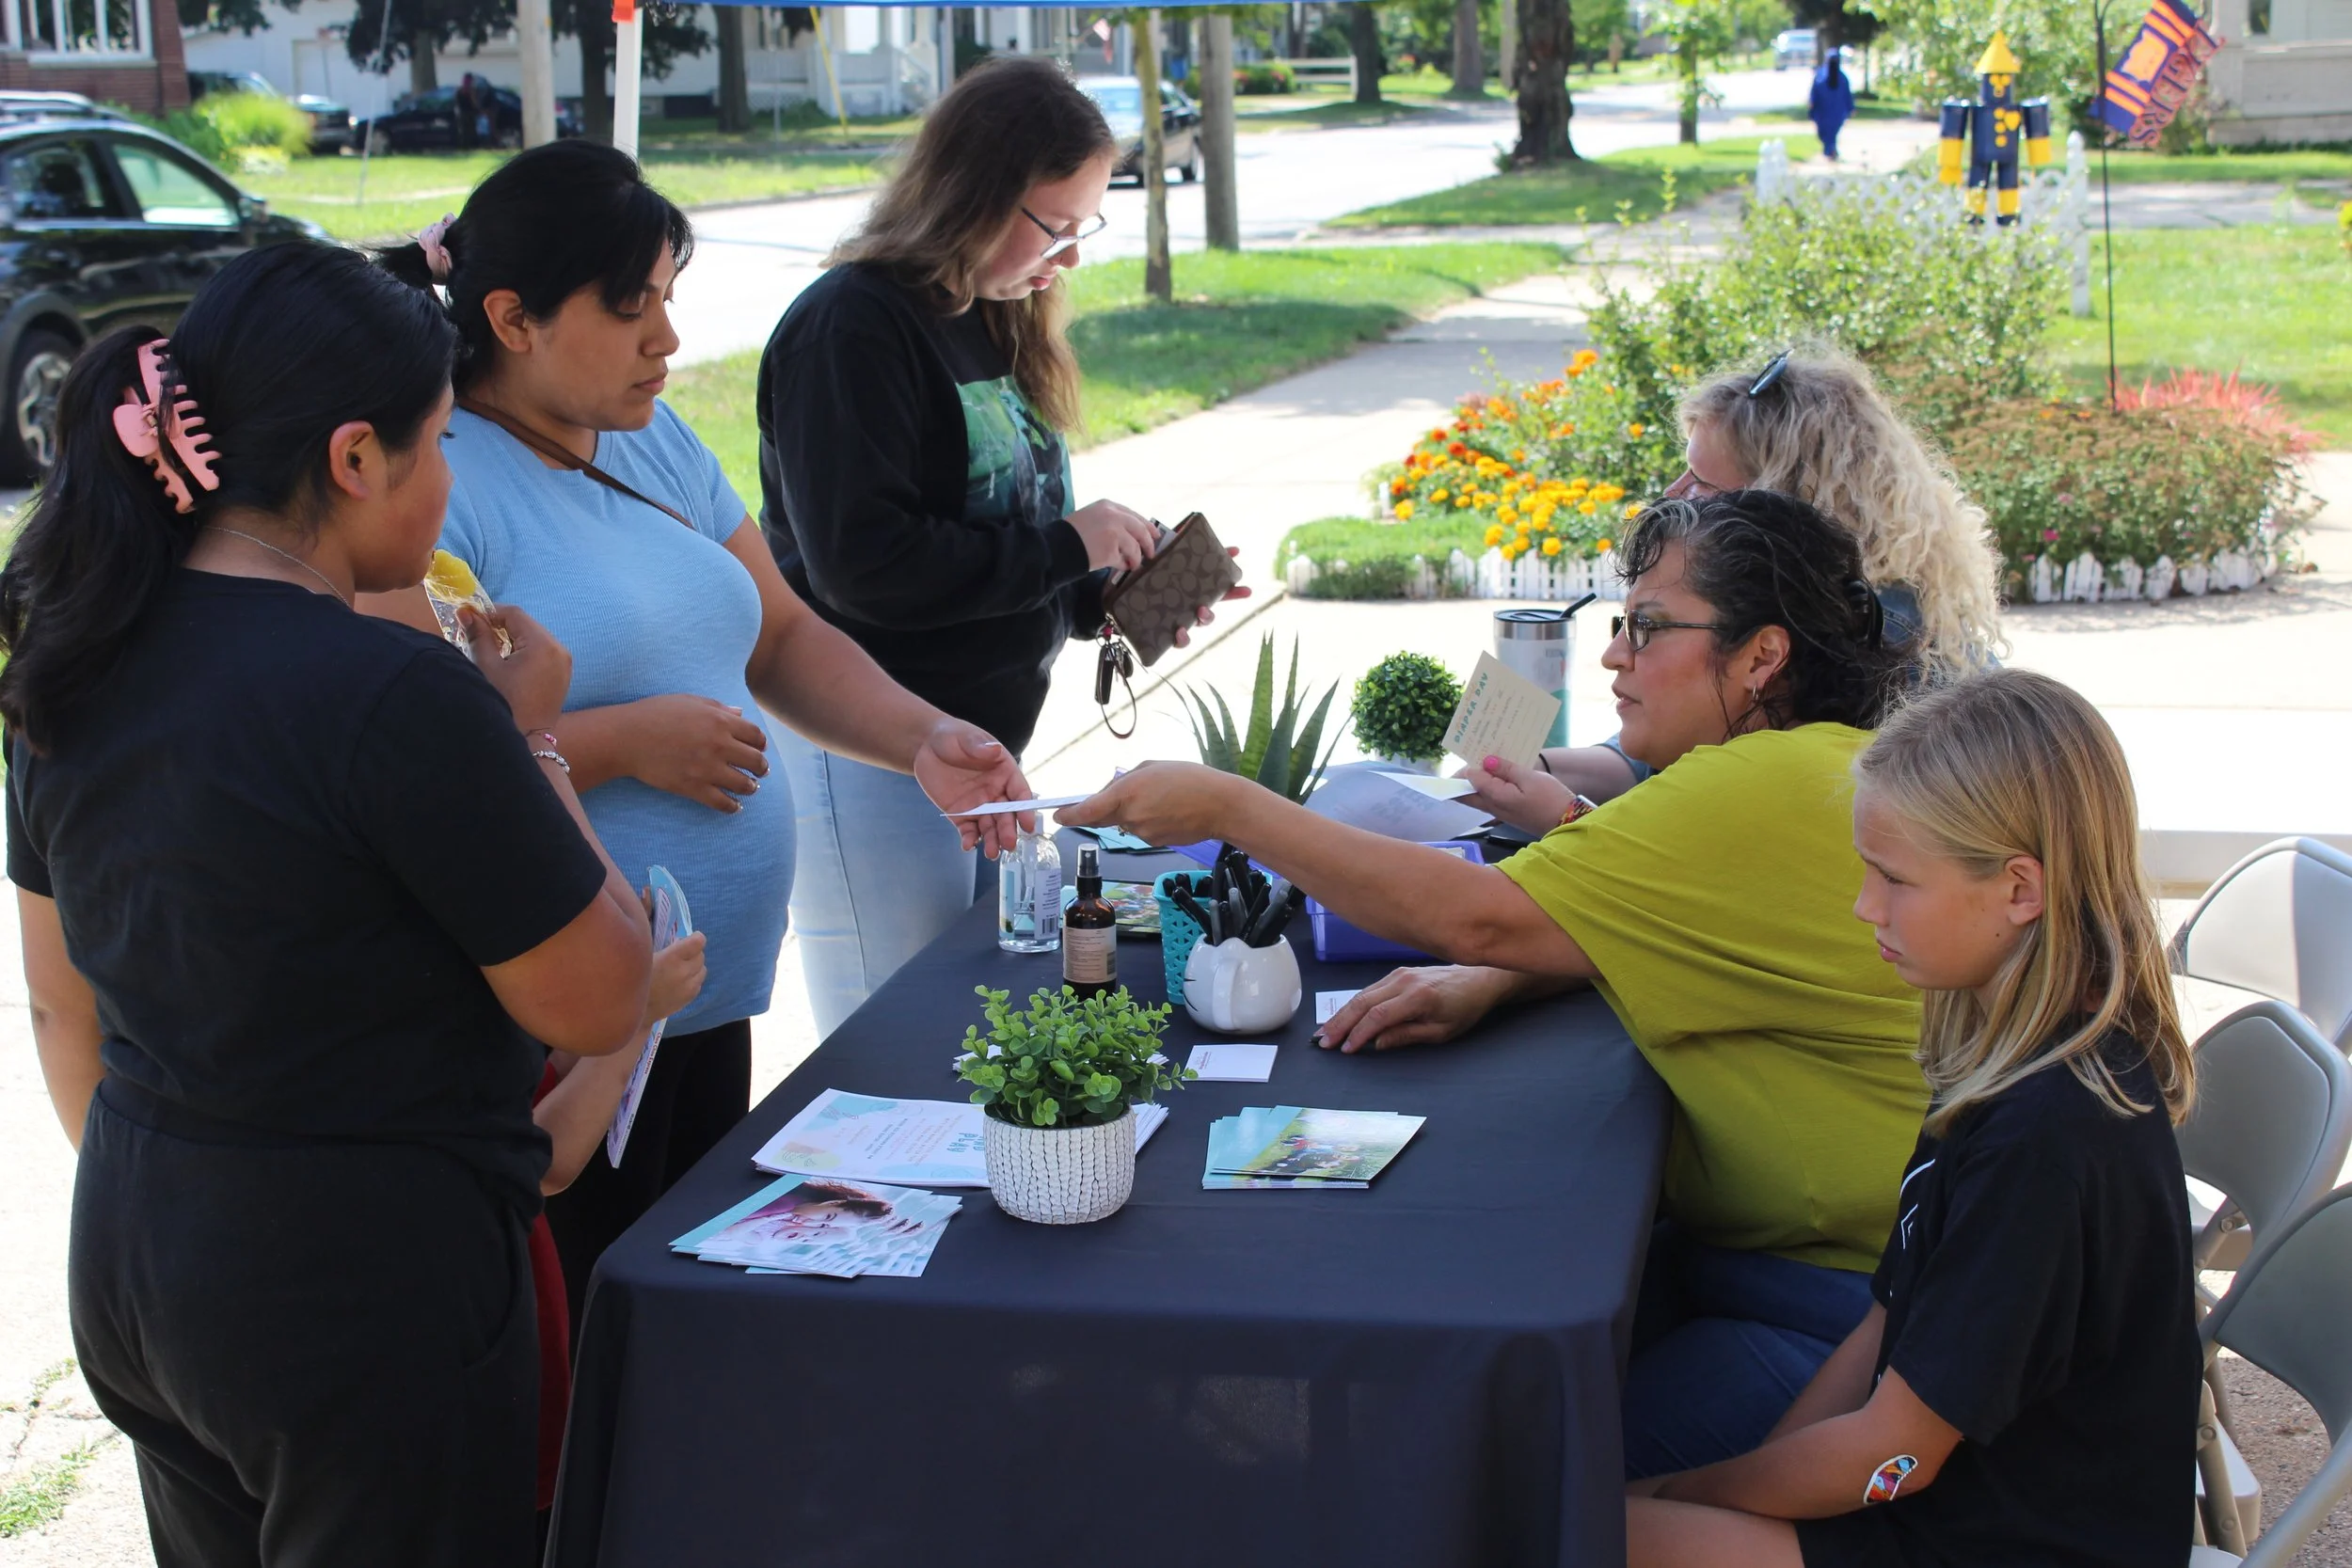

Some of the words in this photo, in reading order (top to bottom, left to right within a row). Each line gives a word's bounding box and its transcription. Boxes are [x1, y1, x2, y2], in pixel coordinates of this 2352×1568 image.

[2129, 17, 2227, 147] TIGERS
[1454, 700, 1477, 744] DIAPER
[946, 1132, 978, 1153] PLAY
